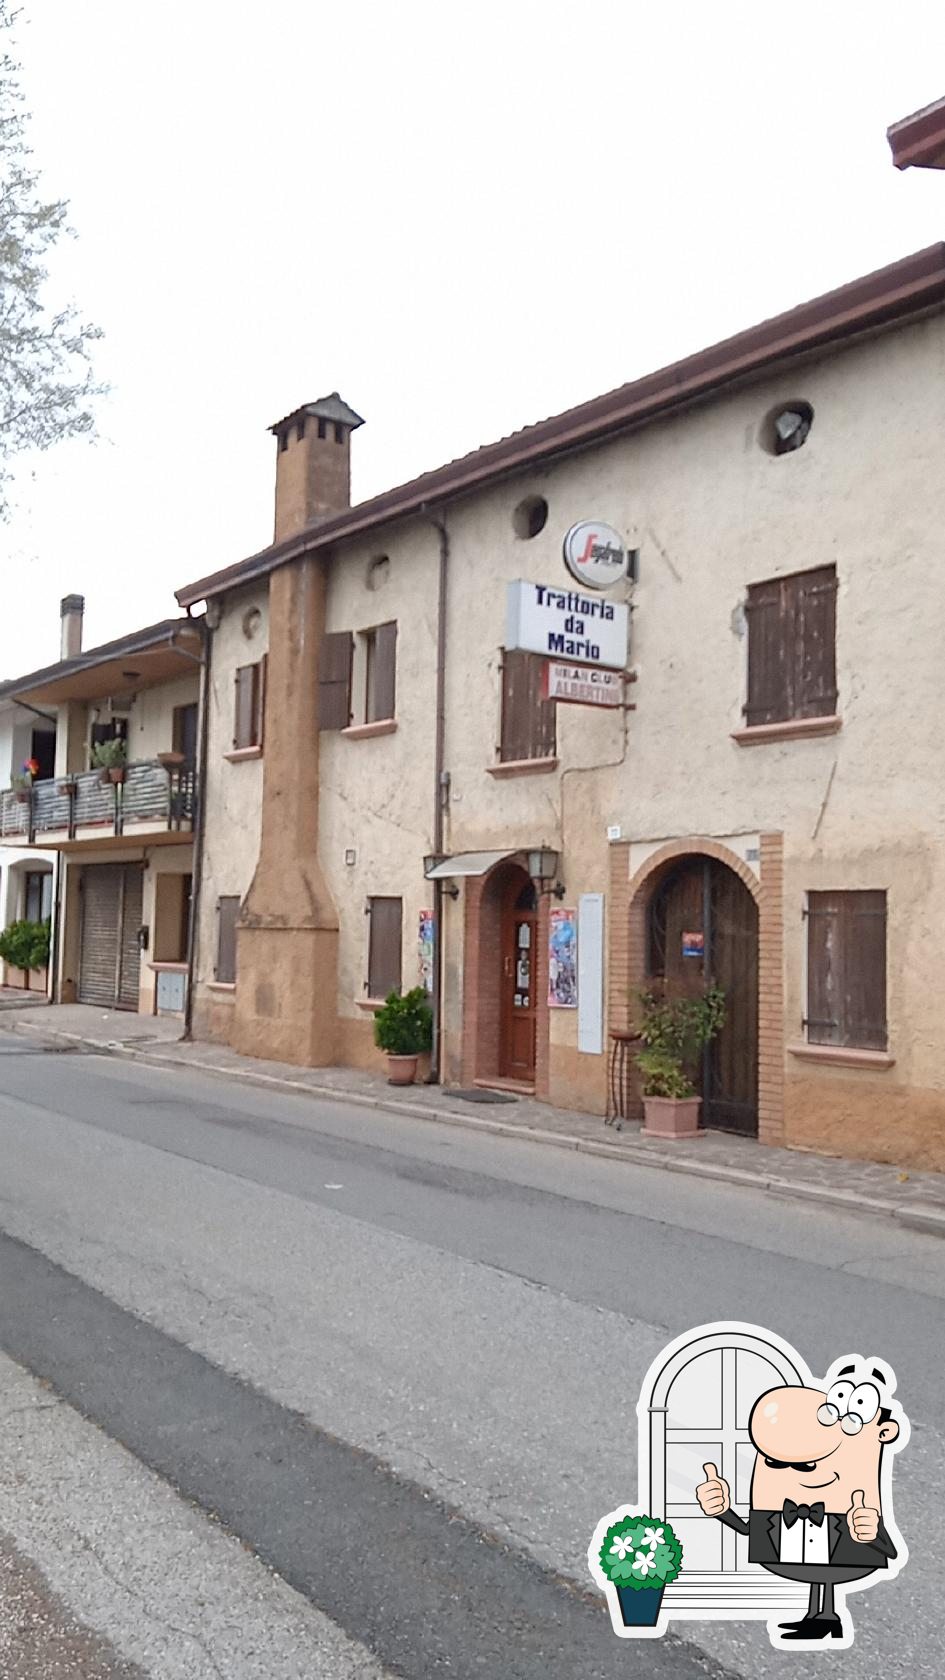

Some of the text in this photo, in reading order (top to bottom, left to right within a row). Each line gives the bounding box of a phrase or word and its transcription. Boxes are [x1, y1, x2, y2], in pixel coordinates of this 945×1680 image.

[535, 586, 614, 620] Trattoria
[564, 616, 585, 635] da
[548, 633, 600, 660] Mario
